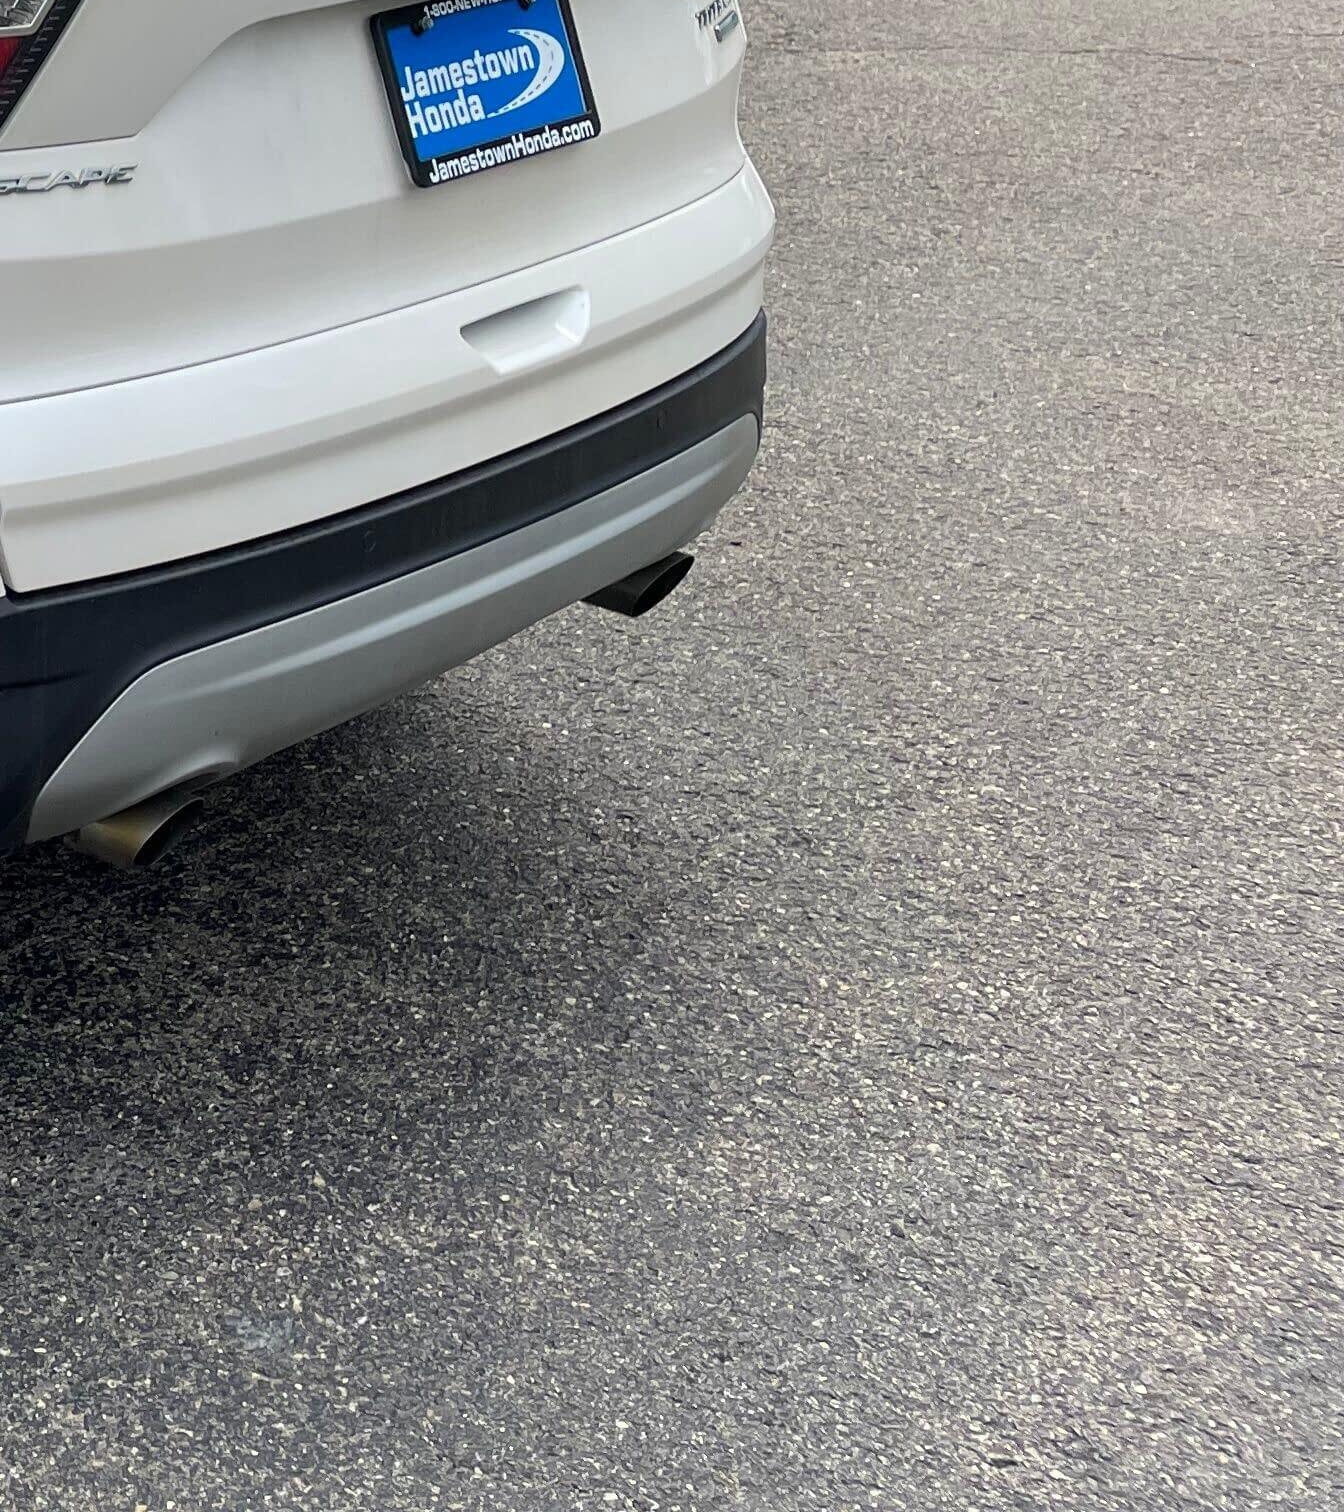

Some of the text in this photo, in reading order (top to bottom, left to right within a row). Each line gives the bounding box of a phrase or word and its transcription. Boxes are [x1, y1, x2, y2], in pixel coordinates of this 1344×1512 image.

[400, 44, 535, 100] Jamestown
[405, 89, 486, 139] Honda
[429, 120, 595, 184] JamestownHonda.com
